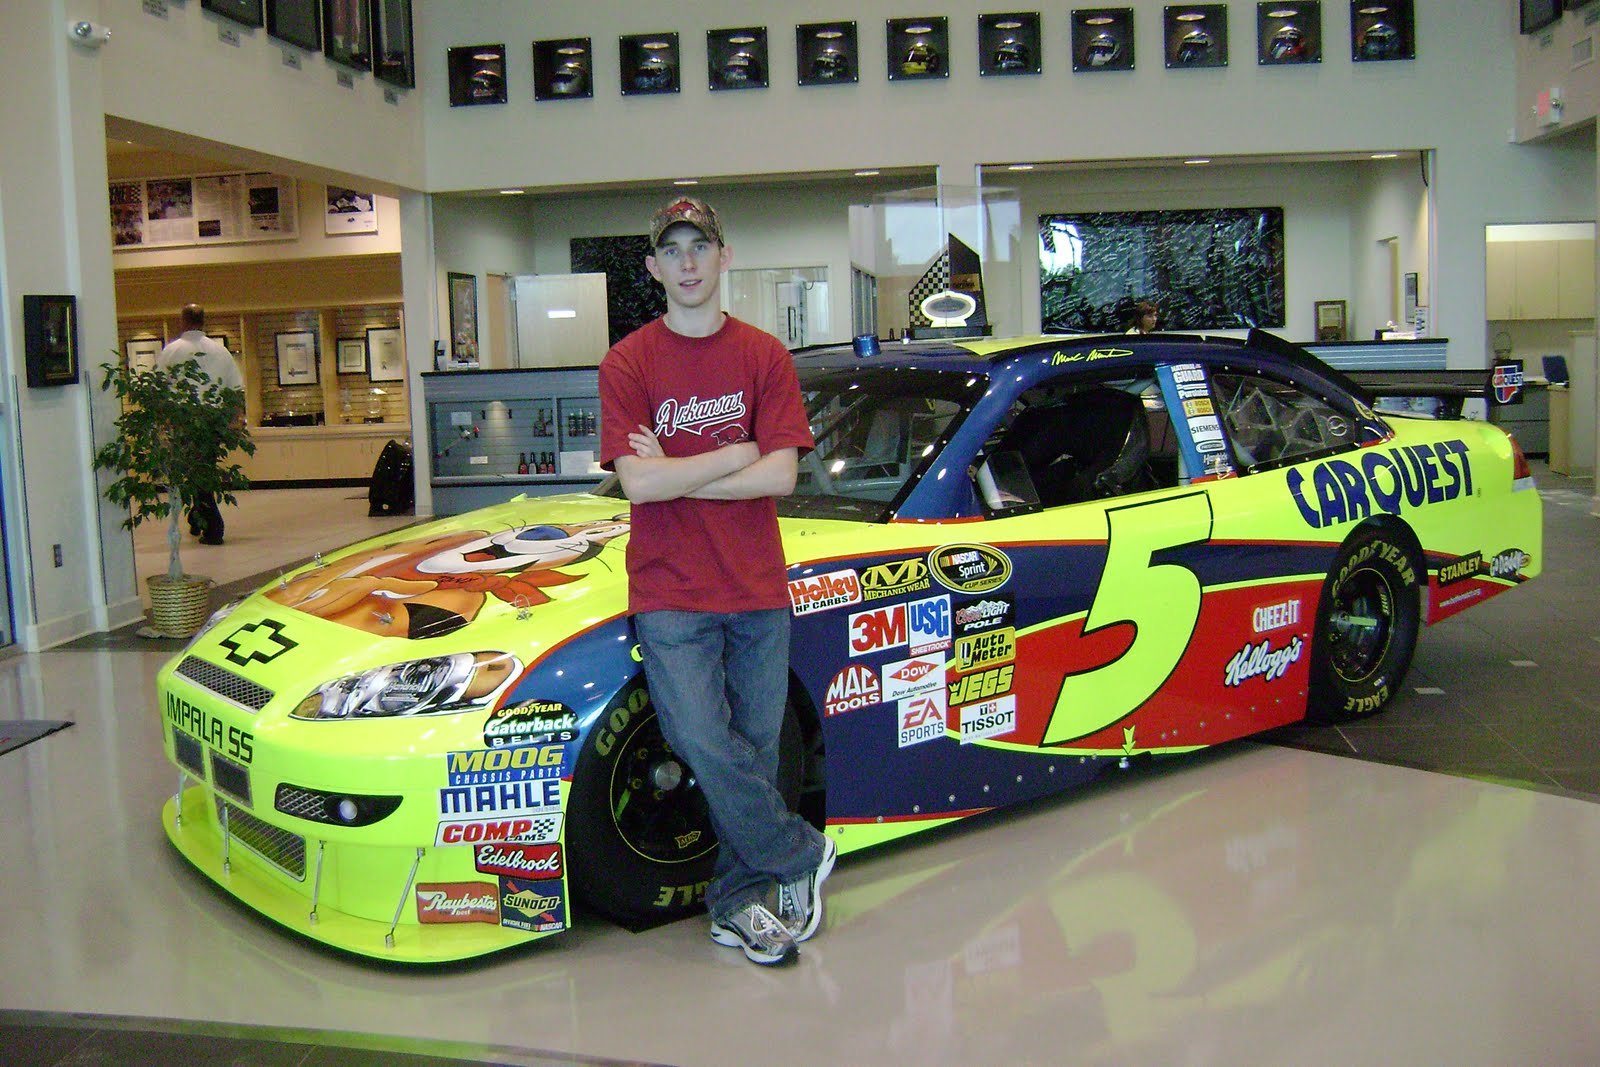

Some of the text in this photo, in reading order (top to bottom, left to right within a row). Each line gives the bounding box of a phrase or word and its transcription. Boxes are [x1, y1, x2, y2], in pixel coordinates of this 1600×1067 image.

[654, 390, 745, 437] Arkansas
[1191, 424, 1220, 435] SIEMENS
[1286, 439, 1473, 529] CARQUEST
[953, 550, 979, 565] NASCAR
[959, 561, 986, 579] Sprint
[1440, 556, 1480, 583] STANLEY
[788, 574, 861, 603] Holley
[864, 577, 931, 601] MECHANIX WEAR
[964, 576, 1003, 589] CUP SERIES
[795, 595, 849, 613] HP CARBS
[982, 602, 1010, 618] LIGHT
[910, 598, 949, 638] USG
[963, 617, 1003, 631] POLE
[1039, 489, 1213, 747] 5
[1253, 599, 1299, 633] CHEEZ-IT
[851, 605, 907, 652] 3M
[973, 633, 1005, 651] Auto
[971, 644, 1012, 664] Meter
[1224, 635, 1303, 687] Kellogg's
[826, 665, 879, 704] MAC
[892, 682, 937, 697] Dow Automotive
[948, 665, 1015, 707] JEGS
[497, 703, 563, 718] GOODYEAR
[826, 693, 880, 716] TOOLS
[1343, 685, 1388, 713] EAGLE
[902, 697, 943, 730] EA
[961, 711, 1014, 734] TISSOT
[166, 691, 254, 764] IMPALA SS
[486, 715, 574, 737] Gatorback
[900, 722, 944, 744] SPORTS
[492, 731, 572, 746] BELTS
[450, 745, 565, 773] MOOG
[455, 767, 560, 785] CHASSIS PARTS
[440, 780, 561, 814] MAHLE
[442, 818, 533, 844] COMP
[504, 833, 547, 842] CAMS
[477, 844, 560, 871] Edelbrock
[504, 895, 559, 910] SUNOCO
